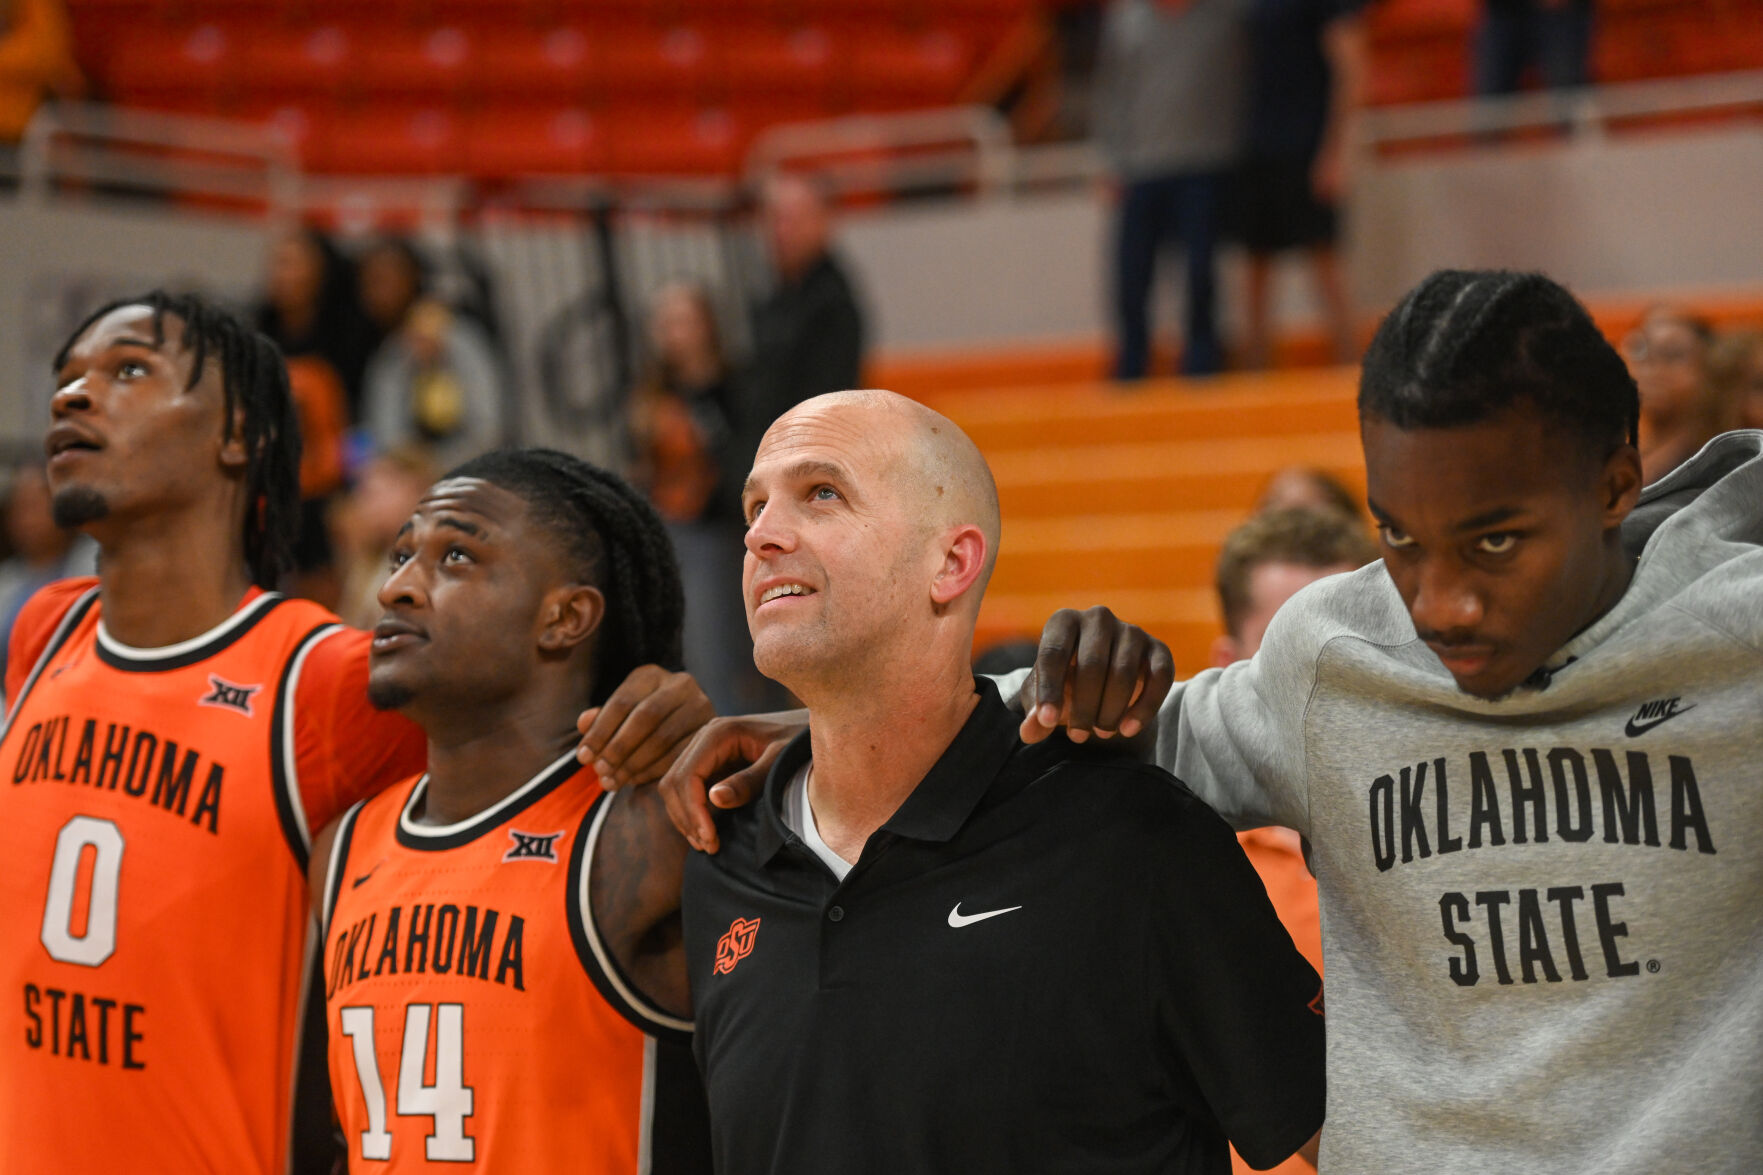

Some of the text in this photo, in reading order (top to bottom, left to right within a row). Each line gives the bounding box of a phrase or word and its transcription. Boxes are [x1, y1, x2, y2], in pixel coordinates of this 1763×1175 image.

[205, 678, 257, 711] XII
[1636, 697, 1681, 721] NIKE
[13, 716, 224, 834] OKLAHOMA
[1369, 747, 1717, 873] OKLAHOMA
[41, 814, 124, 967] 0
[508, 832, 560, 860] XII
[327, 904, 525, 1000] OKLAHOMA
[714, 917, 760, 974] OSU
[1439, 882, 1640, 987] STATE
[25, 984, 145, 1069] STATE
[341, 1003, 475, 1161] 14
